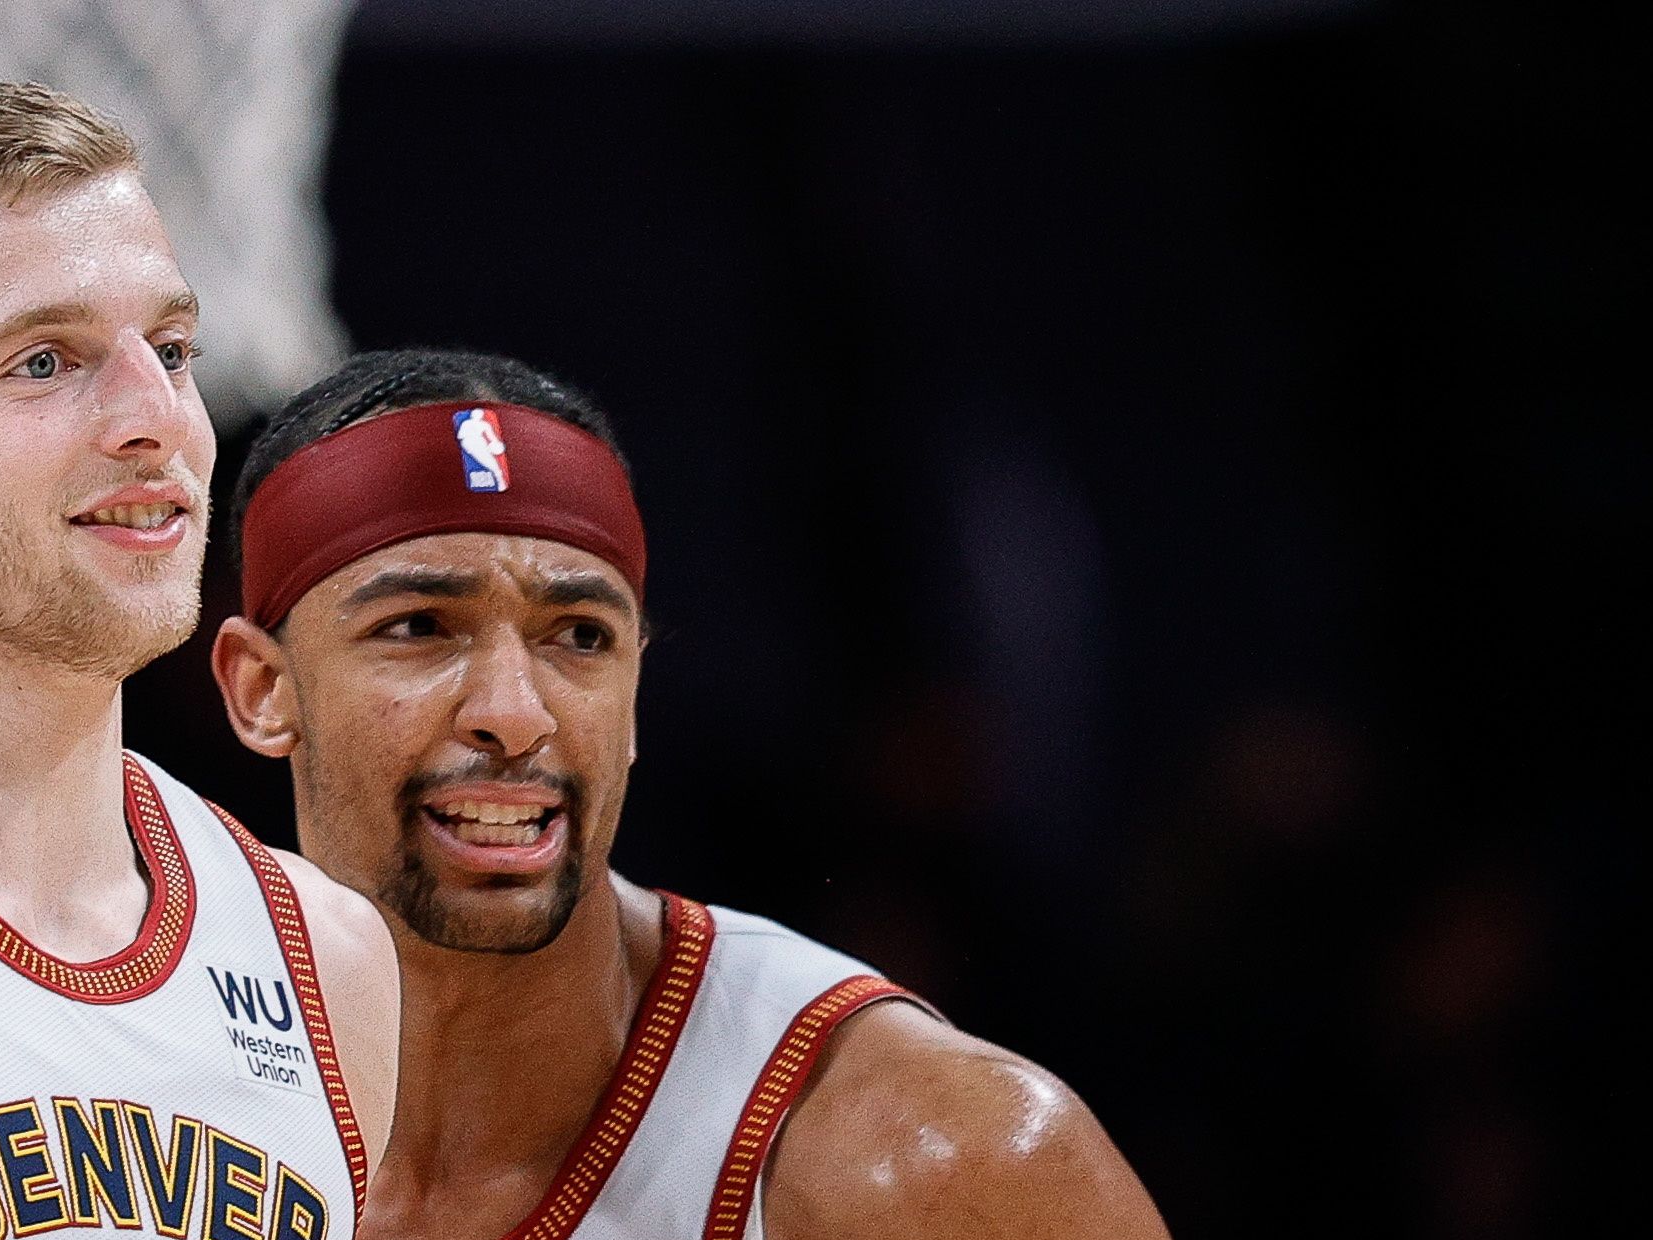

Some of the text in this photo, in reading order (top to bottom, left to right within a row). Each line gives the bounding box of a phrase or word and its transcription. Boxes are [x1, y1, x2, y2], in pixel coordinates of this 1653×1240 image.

[206, 966, 293, 1032] WU
[226, 1025, 307, 1064] Western
[247, 1054, 303, 1088] Union
